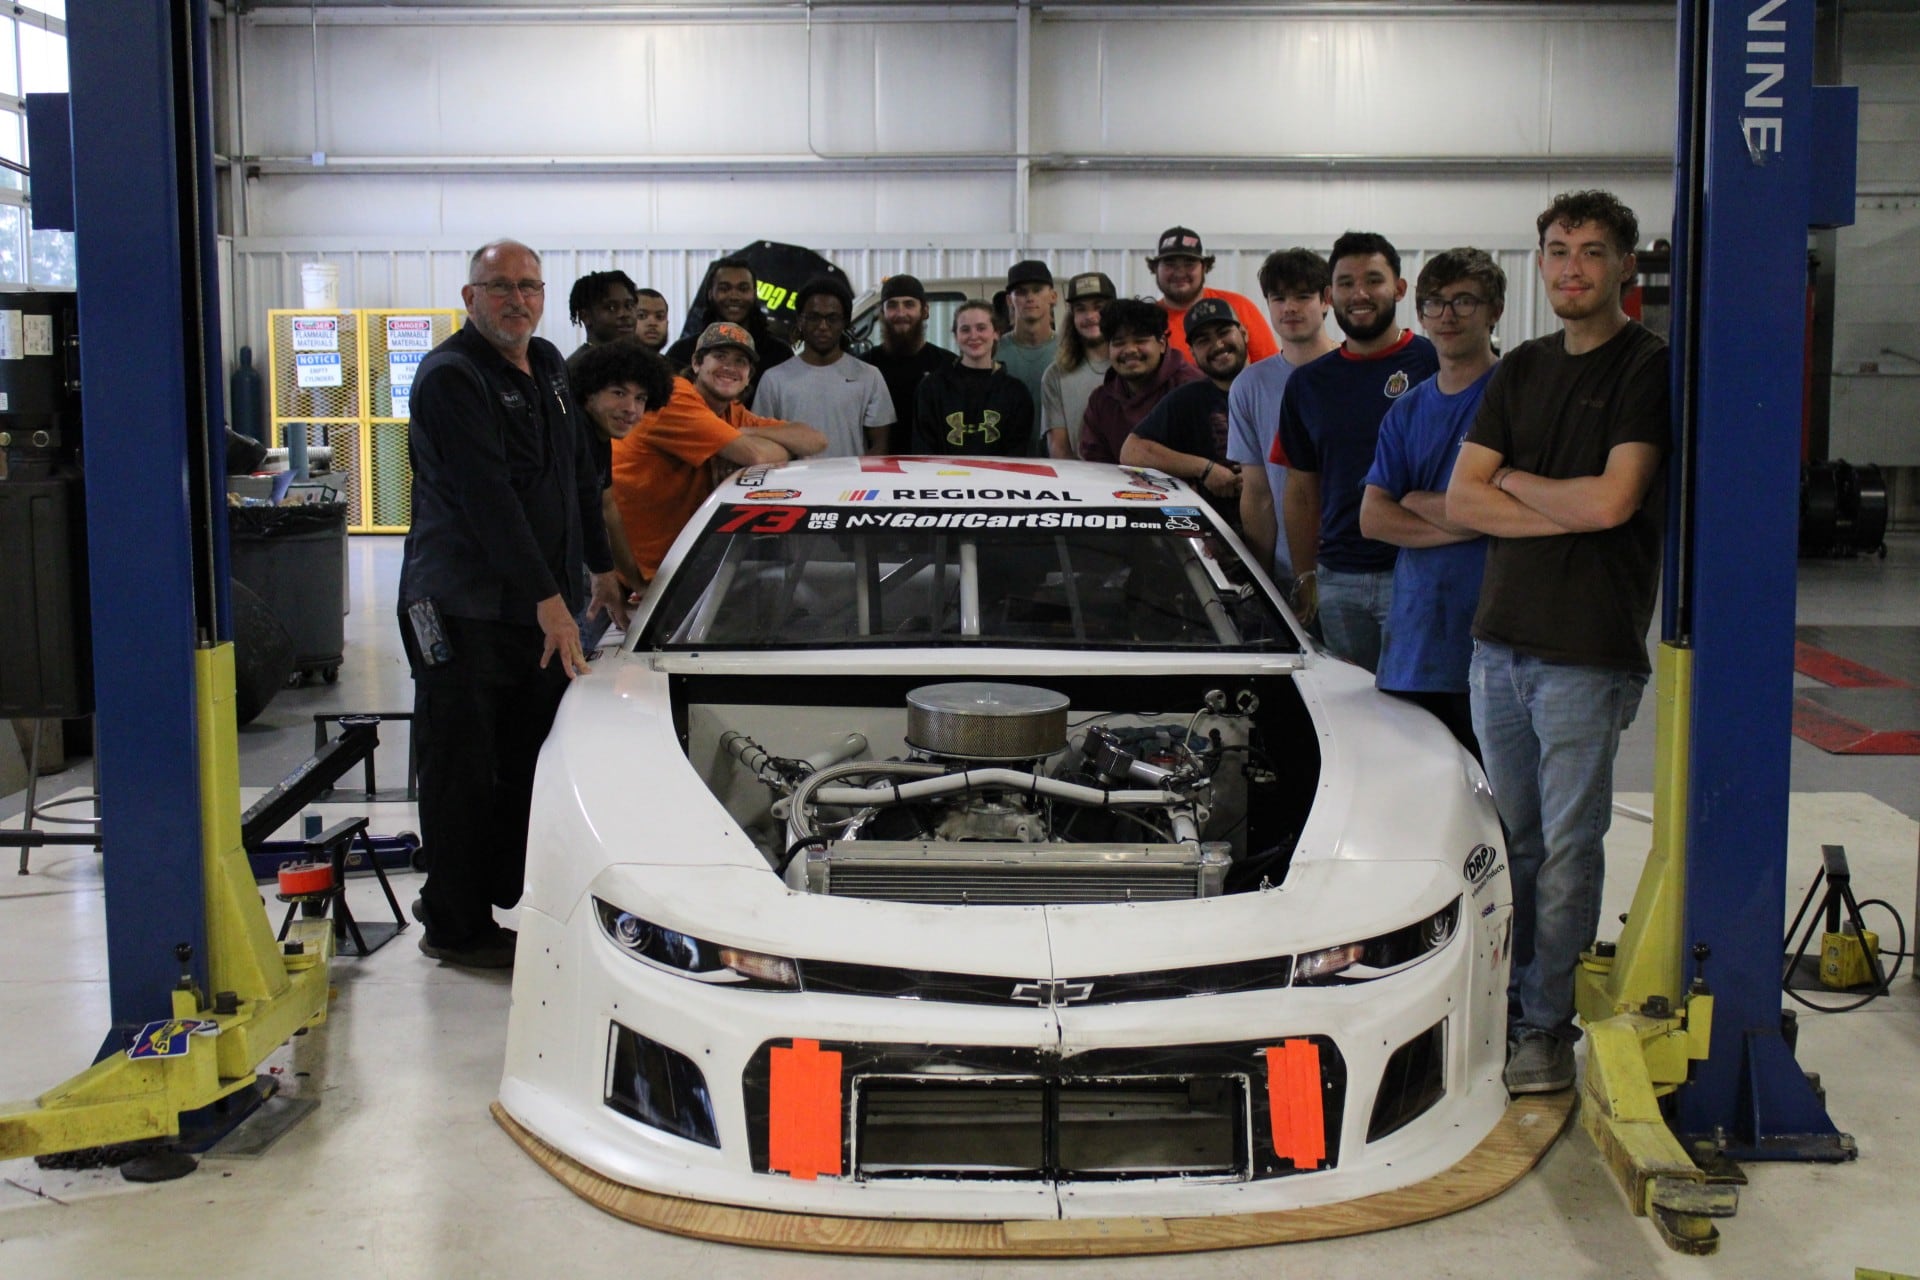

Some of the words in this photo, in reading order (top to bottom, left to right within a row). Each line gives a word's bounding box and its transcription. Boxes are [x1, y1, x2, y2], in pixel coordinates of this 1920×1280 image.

[394, 322, 425, 330] DANGER
[295, 330, 334, 339] FLAMMABLE
[390, 330, 428, 339] FLAMMABLE
[297, 339, 333, 347] MATERIALS
[391, 339, 427, 347] MATERIALS
[300, 355, 335, 364] NOTICE
[394, 354, 423, 363] NOTIC
[893, 488, 1083, 501] REGIONAL
[715, 504, 808, 533] 73
[810, 512, 839, 521] MG
[807, 520, 839, 529] CS
[1467, 847, 1489, 881] DRP
